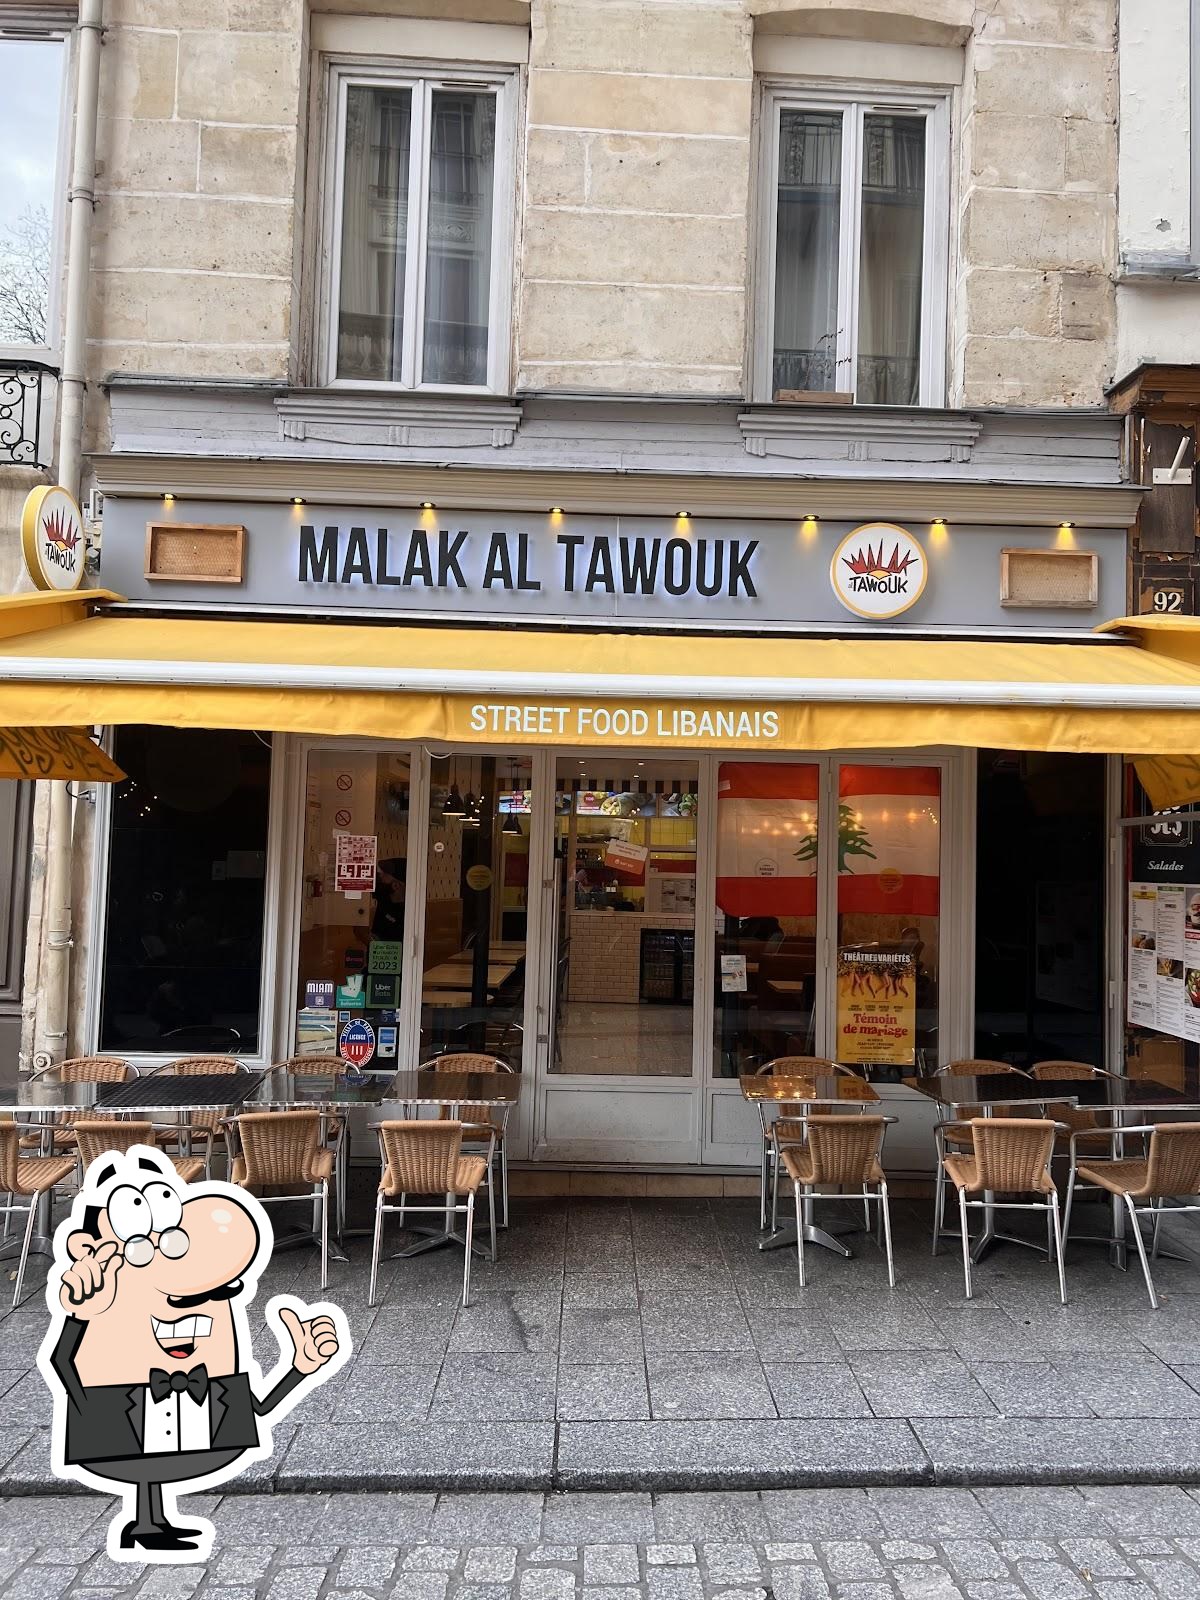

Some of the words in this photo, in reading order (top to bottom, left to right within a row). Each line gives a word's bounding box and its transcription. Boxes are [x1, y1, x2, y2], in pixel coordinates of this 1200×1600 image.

[45, 543, 76, 573] TAWOUK
[298, 525, 470, 590] MALAK
[482, 532, 541, 591] AL
[557, 535, 760, 598] TAWOUK
[849, 575, 909, 594] TAWOUK
[1153, 591, 1182, 612] 92
[470, 704, 571, 735] STREET
[577, 707, 649, 737] FOOD
[656, 709, 779, 739] LIBANAIS
[1147, 860, 1185, 871] Salades
[877, 952, 911, 963] VARIÉTÉS
[372, 961, 398, 970] 2023
[307, 983, 333, 993] MIAM
[853, 1012, 897, 1024] Témoin
[843, 1023, 858, 1034] de
[859, 1025, 908, 1038] mariage
[351, 1045, 364, 1056] III
